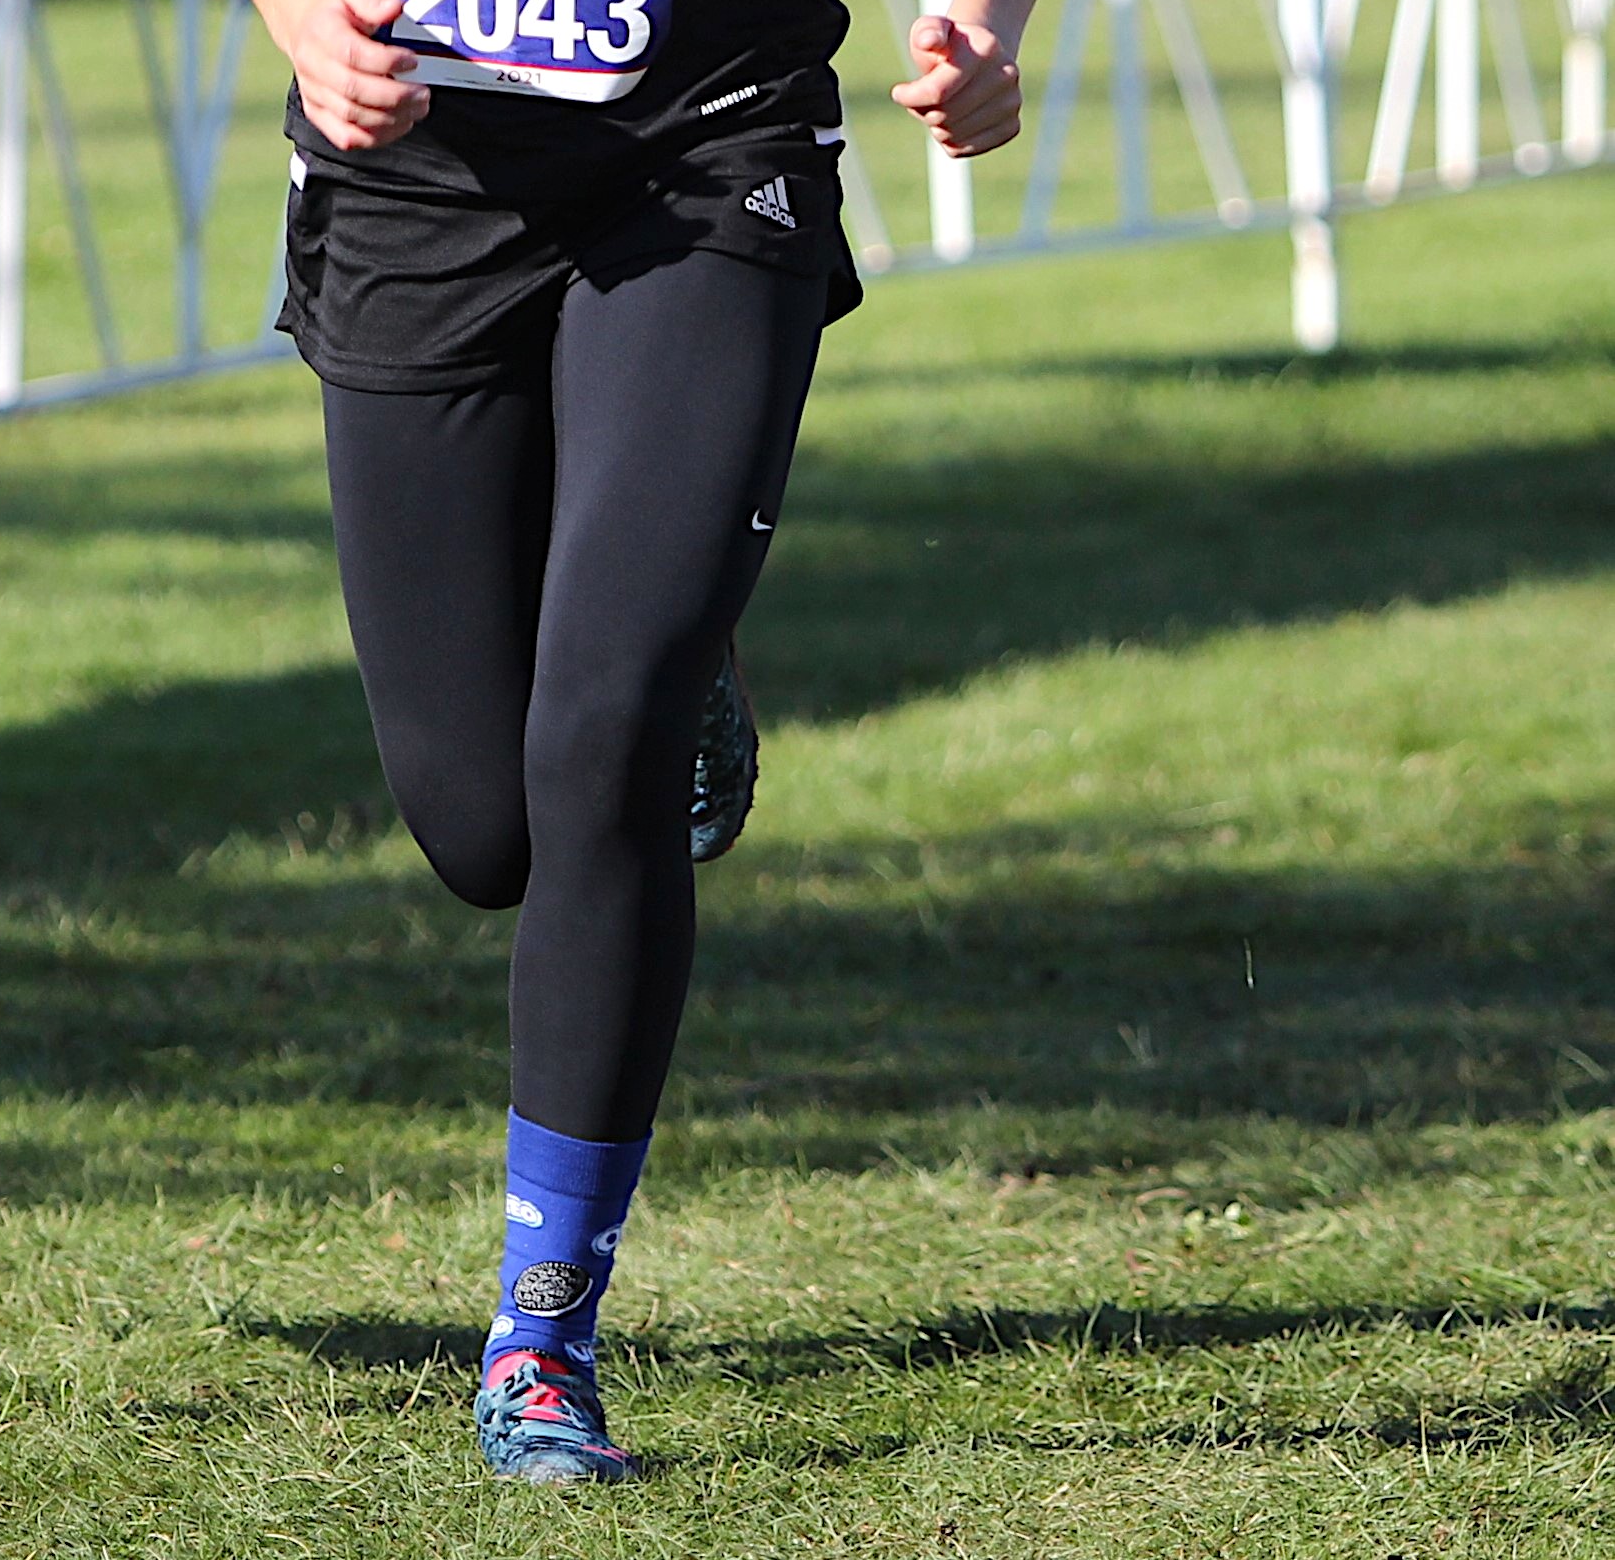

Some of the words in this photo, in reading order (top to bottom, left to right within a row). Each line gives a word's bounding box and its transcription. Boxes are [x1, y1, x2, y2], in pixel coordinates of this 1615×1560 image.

[495, 69, 542, 85] 2021
[700, 84, 758, 116] AEROREADY
[744, 196, 796, 228] adidas
